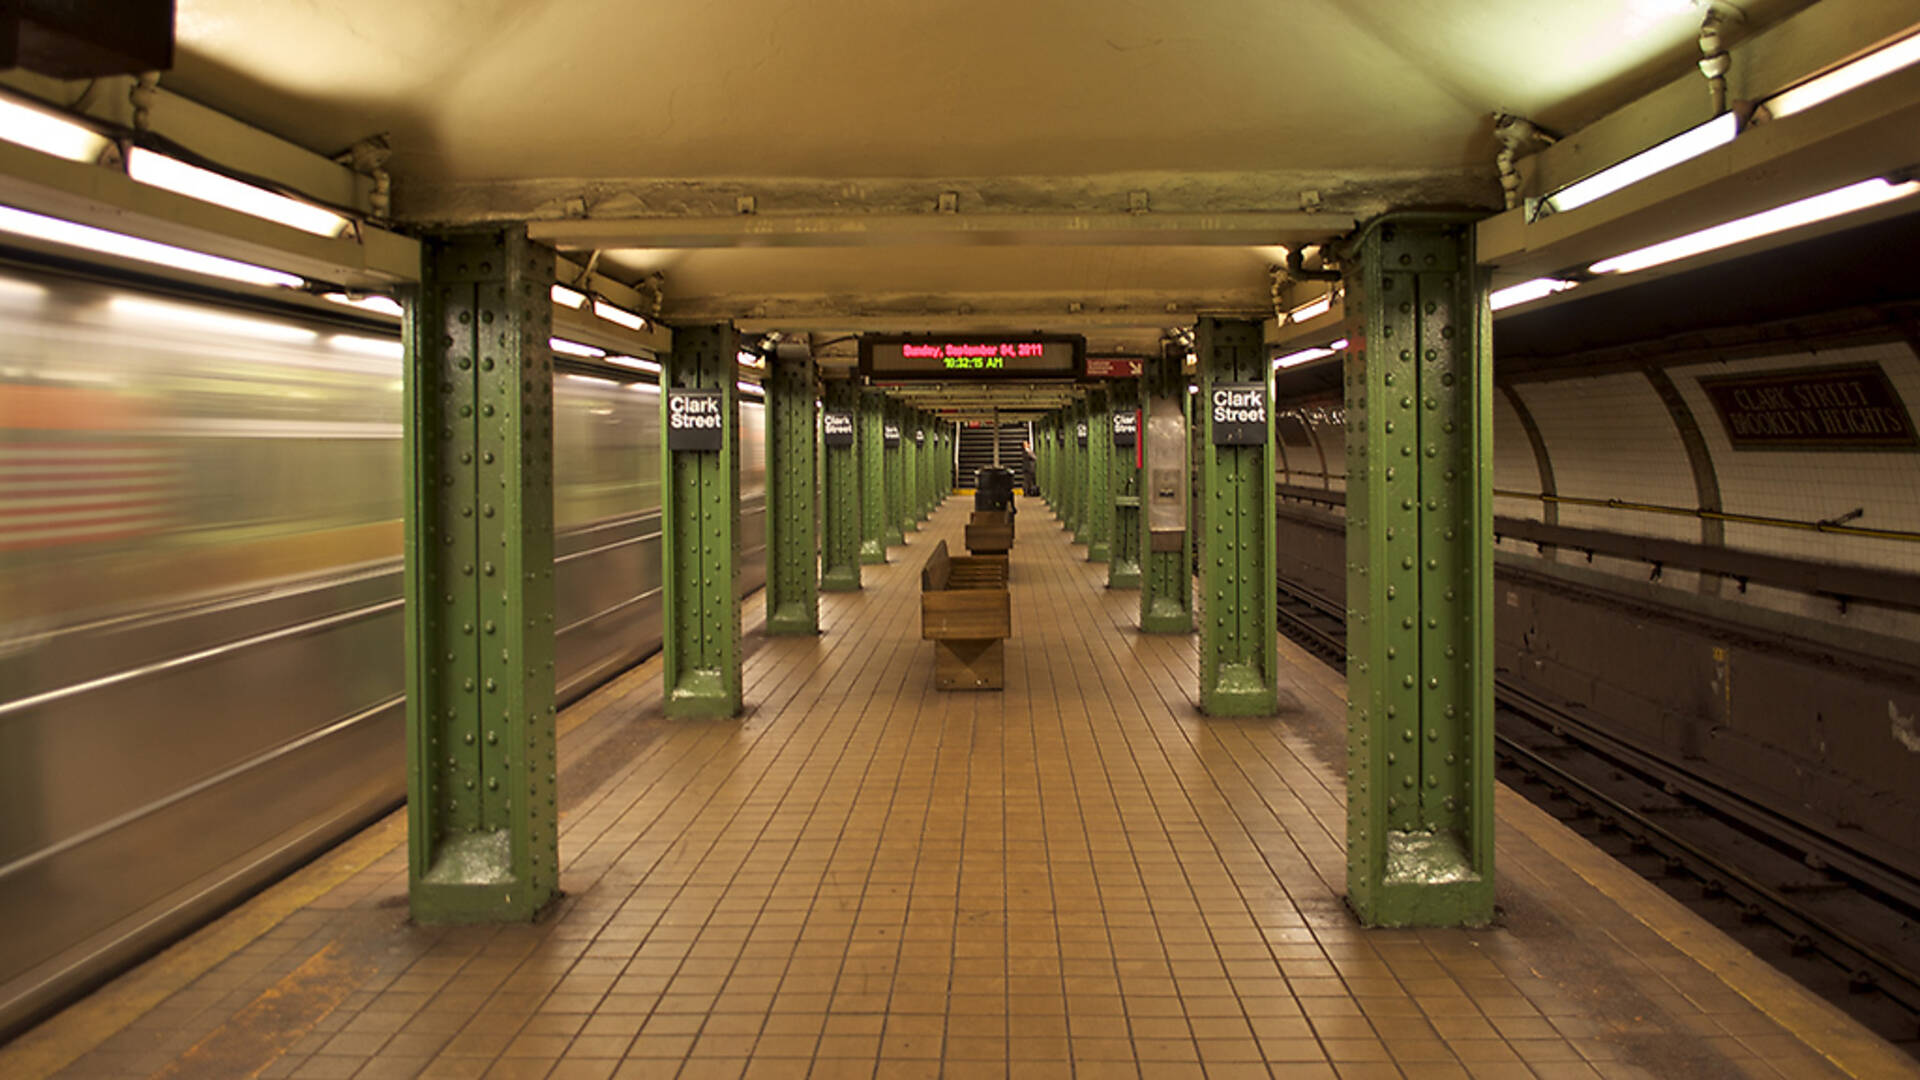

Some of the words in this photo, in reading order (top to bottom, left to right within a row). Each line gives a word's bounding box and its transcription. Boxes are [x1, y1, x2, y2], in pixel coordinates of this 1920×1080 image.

[903, 343, 944, 359] Sunday,
[945, 343, 998, 358] September
[985, 357, 1003, 369] AM
[1213, 390, 1263, 407] Clark
[1732, 386, 1795, 411] CLARK
[1794, 380, 1869, 408] STREET
[670, 396, 719, 413] Clark
[671, 412, 722, 428] Street
[1214, 406, 1266, 422] Street
[1816, 407, 1904, 434] HEIGHTS
